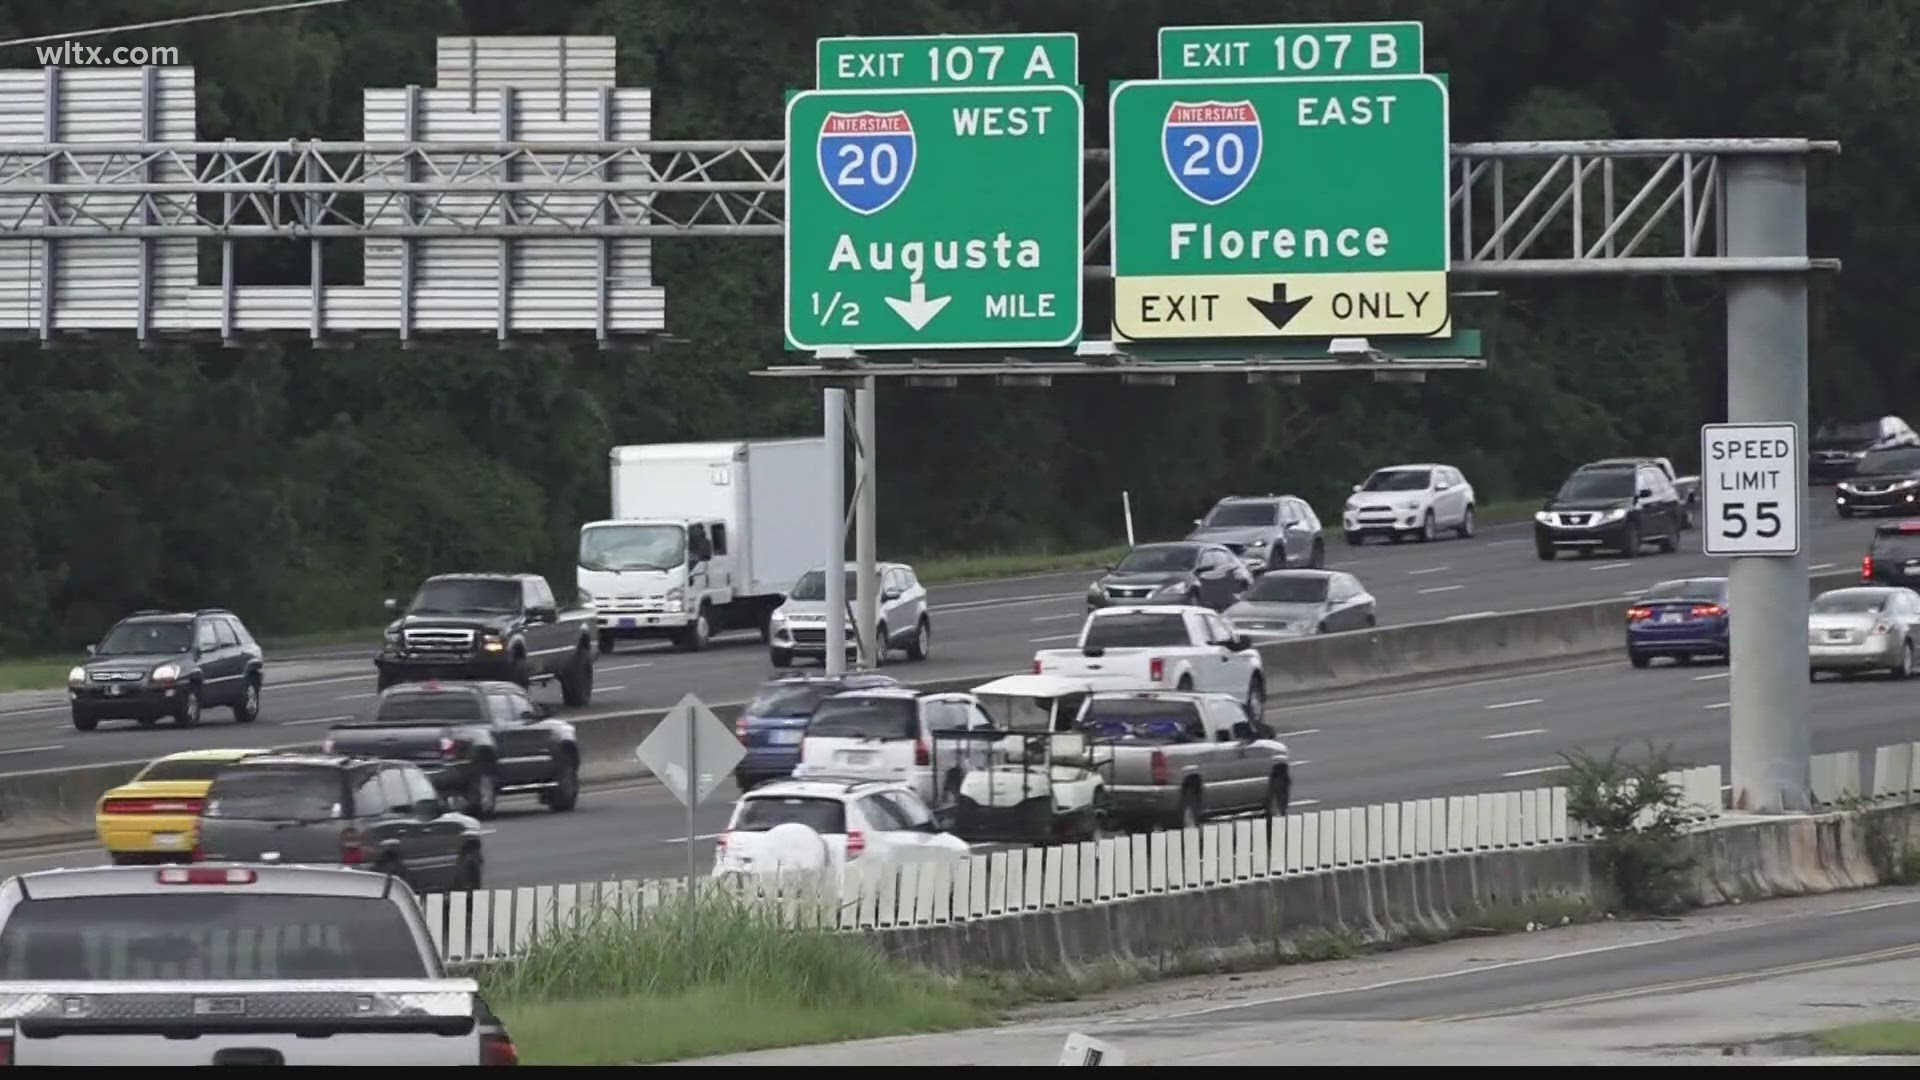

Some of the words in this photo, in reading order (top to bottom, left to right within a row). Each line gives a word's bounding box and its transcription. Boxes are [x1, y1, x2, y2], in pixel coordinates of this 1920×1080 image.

[837, 54, 904, 79] EXIT
[929, 45, 1004, 80] 107
[1024, 45, 1055, 80] A
[1182, 43, 1250, 68] EXIT
[1275, 35, 1351, 70] 107
[1371, 35, 1398, 69] B
[832, 117, 901, 132] INTERSTATE
[953, 107, 1052, 135] WEST
[1177, 106, 1246, 122] INTERSTATE
[1298, 97, 1396, 126] EAST
[837, 144, 897, 186] 20
[1183, 133, 1243, 176] 20
[828, 232, 1041, 282] Augusta
[1170, 222, 1389, 259] Florence
[811, 292, 860, 327] 1/2
[985, 294, 1056, 318] MILE
[1141, 295, 1219, 322] EXIT
[1331, 291, 1430, 319] ONLY
[1712, 440, 1789, 460] SPEED
[1721, 470, 1780, 490] LIMIT
[1722, 502, 1781, 539] 55
